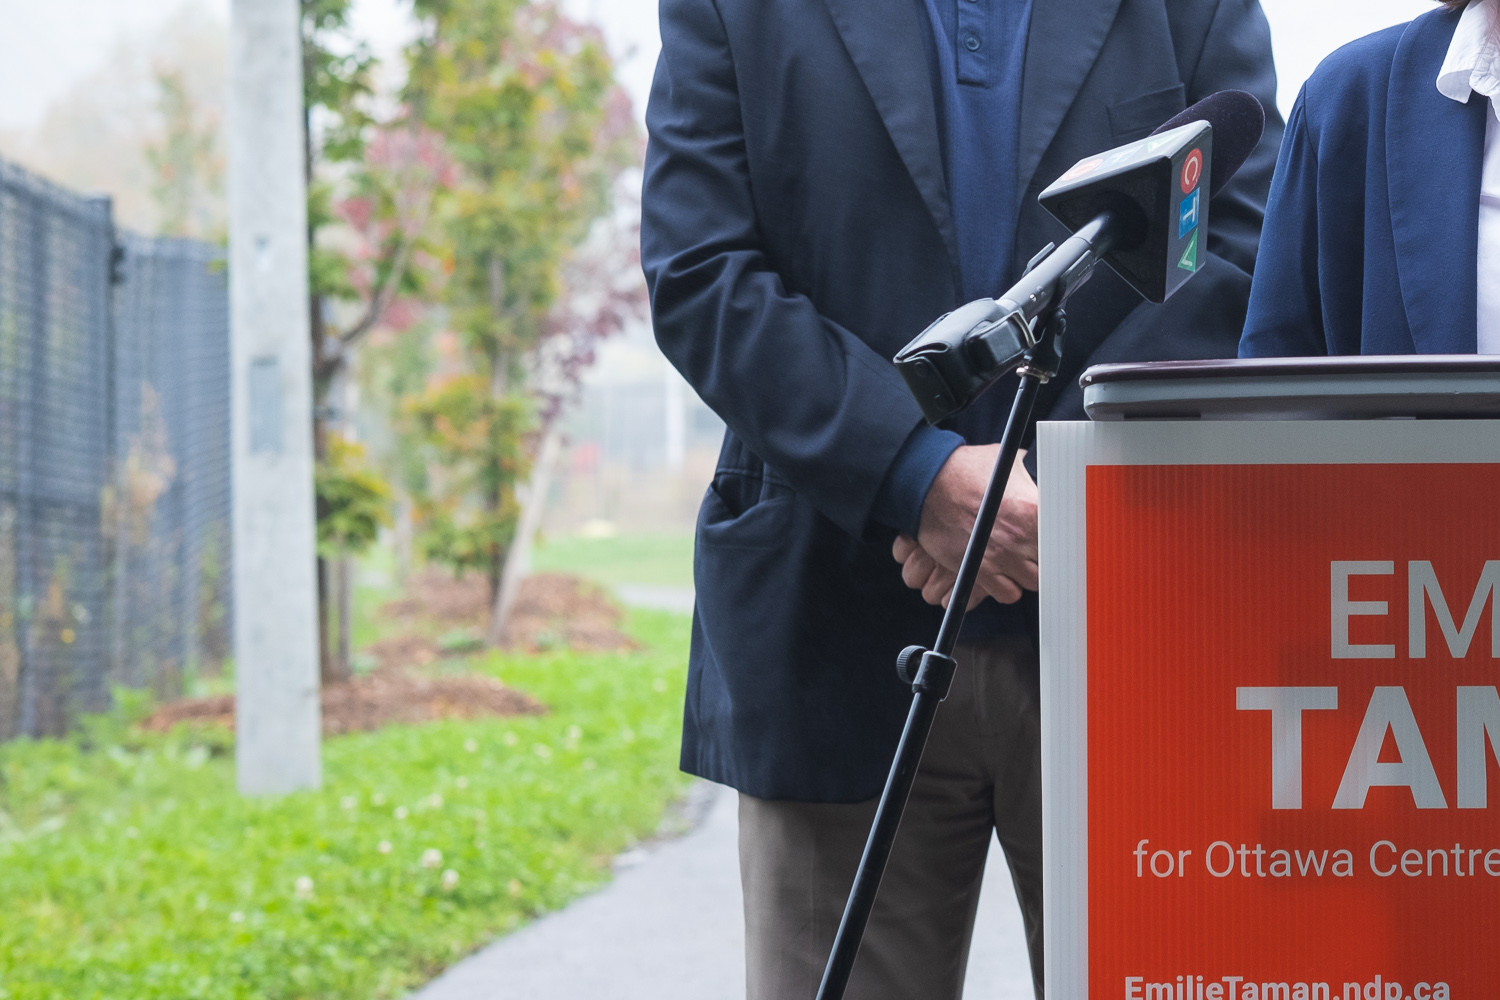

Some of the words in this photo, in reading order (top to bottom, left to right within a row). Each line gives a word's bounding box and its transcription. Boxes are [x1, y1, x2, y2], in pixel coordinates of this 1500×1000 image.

[1133, 839, 1192, 878] for
[1205, 839, 1354, 878] Ottawa
[1124, 974, 1451, 1000] EmilieTaman.ndp.ca
